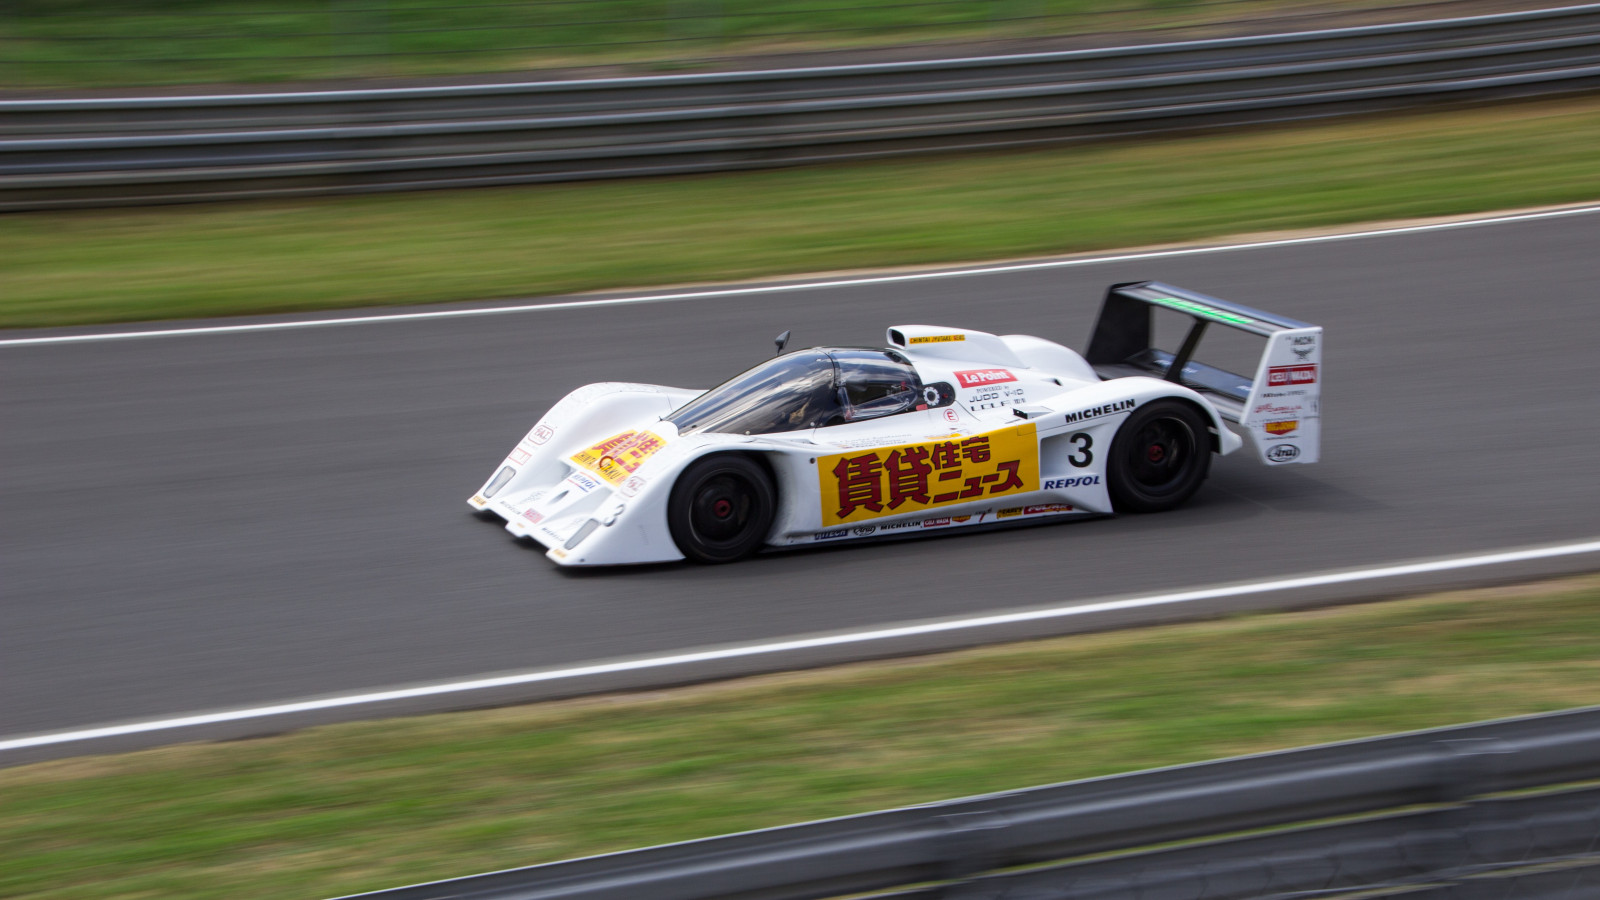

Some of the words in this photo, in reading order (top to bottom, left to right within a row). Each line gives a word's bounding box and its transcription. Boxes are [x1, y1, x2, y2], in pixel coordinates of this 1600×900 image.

[962, 373, 977, 383] Le
[977, 371, 1011, 381] Point
[969, 392, 999, 402] JUDD
[1065, 399, 1136, 423] MICHELIN
[1068, 432, 1093, 468] 3
[1044, 475, 1101, 490] REPSOL
[603, 503, 625, 527] 3
[880, 521, 921, 531] MICHELIN
